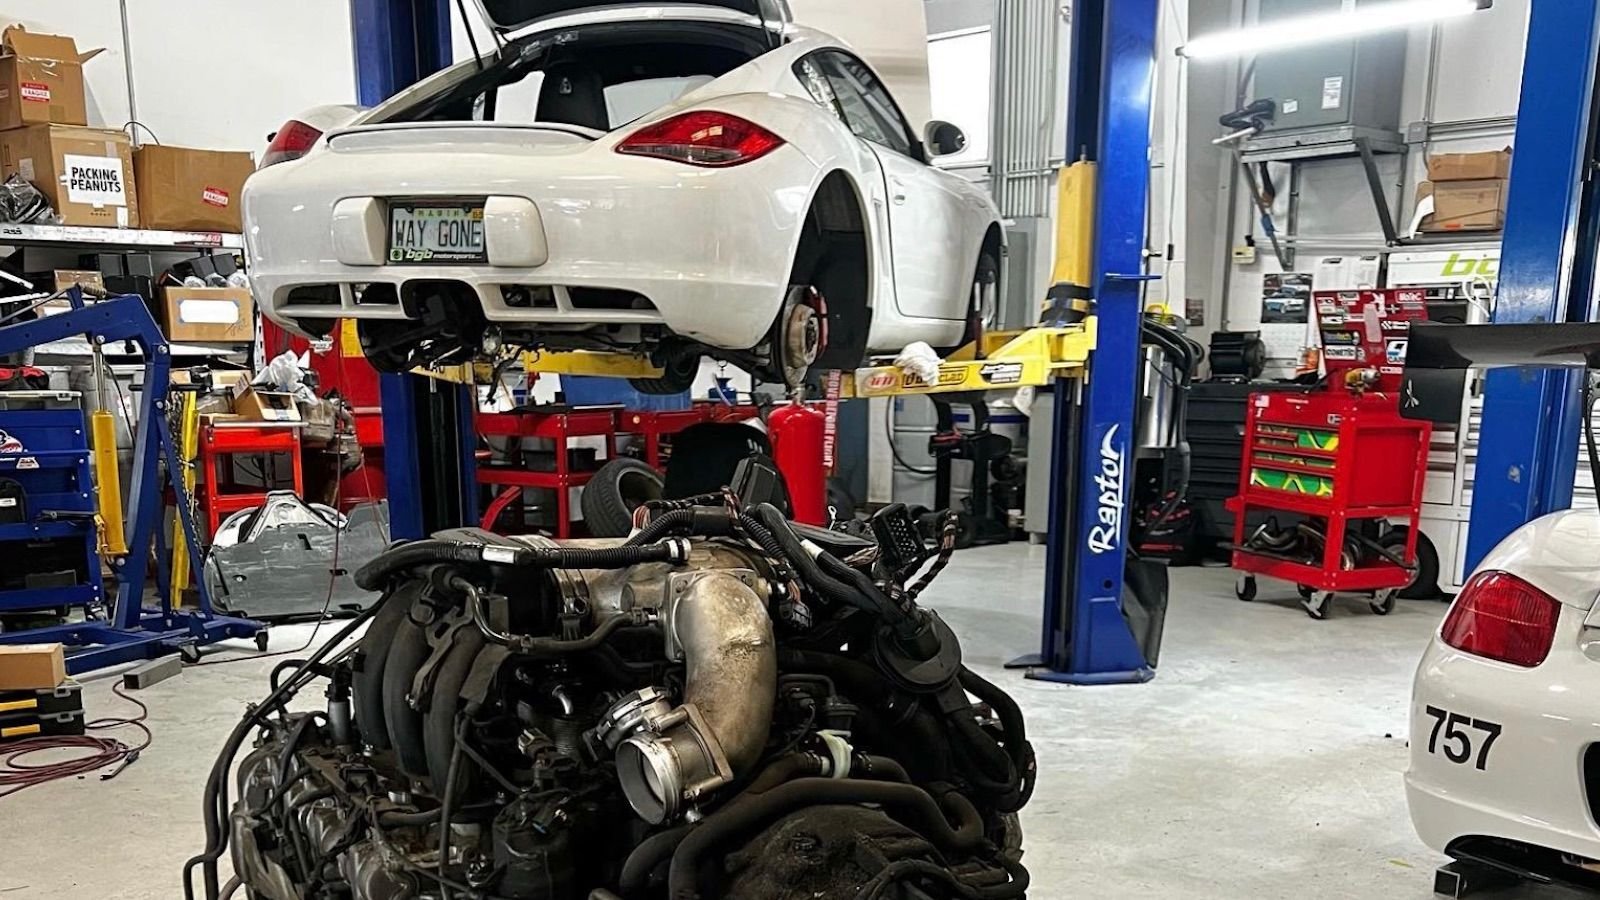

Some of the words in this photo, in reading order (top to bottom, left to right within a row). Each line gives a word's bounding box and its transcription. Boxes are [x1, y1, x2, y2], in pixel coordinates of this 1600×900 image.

[71, 166, 118, 181] PACKING
[70, 178, 121, 193] PEANUTS
[395, 219, 427, 247] WAY
[438, 219, 481, 247] GONE
[405, 248, 433, 261] bgb
[1087, 422, 1124, 554] Raptor
[1426, 704, 1502, 771] 757
